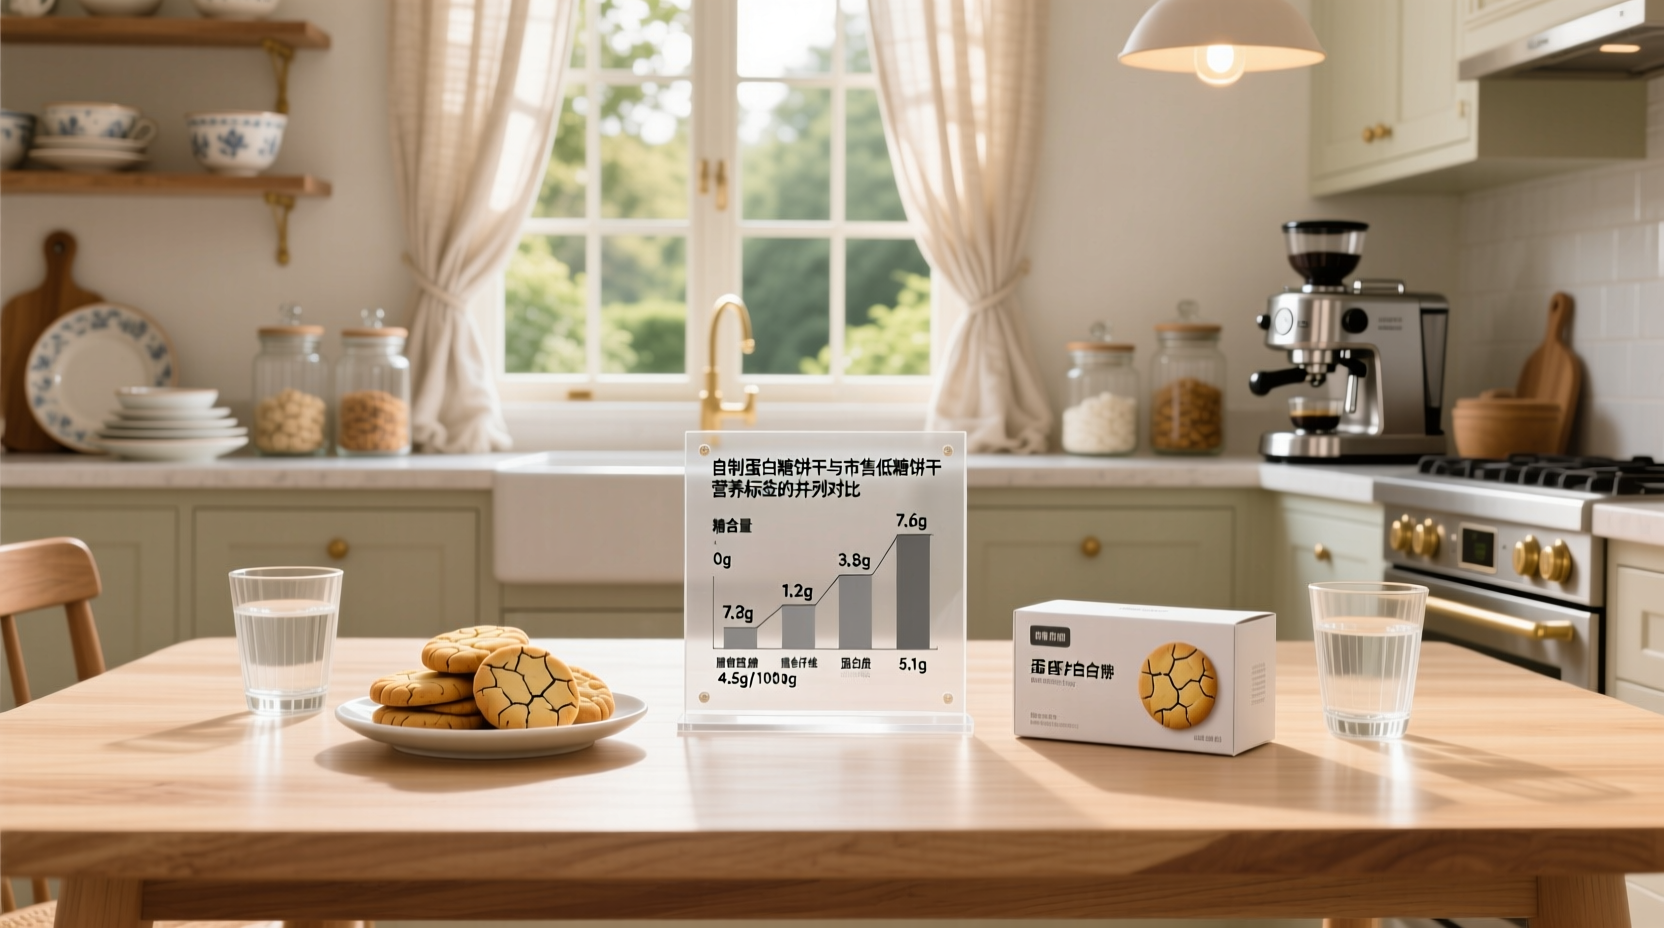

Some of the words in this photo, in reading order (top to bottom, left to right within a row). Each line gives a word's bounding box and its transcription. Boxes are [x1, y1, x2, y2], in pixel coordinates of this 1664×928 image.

[896, 512, 927, 531] 7.6g
[713, 551, 732, 570] 0g
[838, 552, 871, 570] 3.8g
[781, 583, 813, 601] 1.2g
[898, 657, 927, 674] 5.1g
